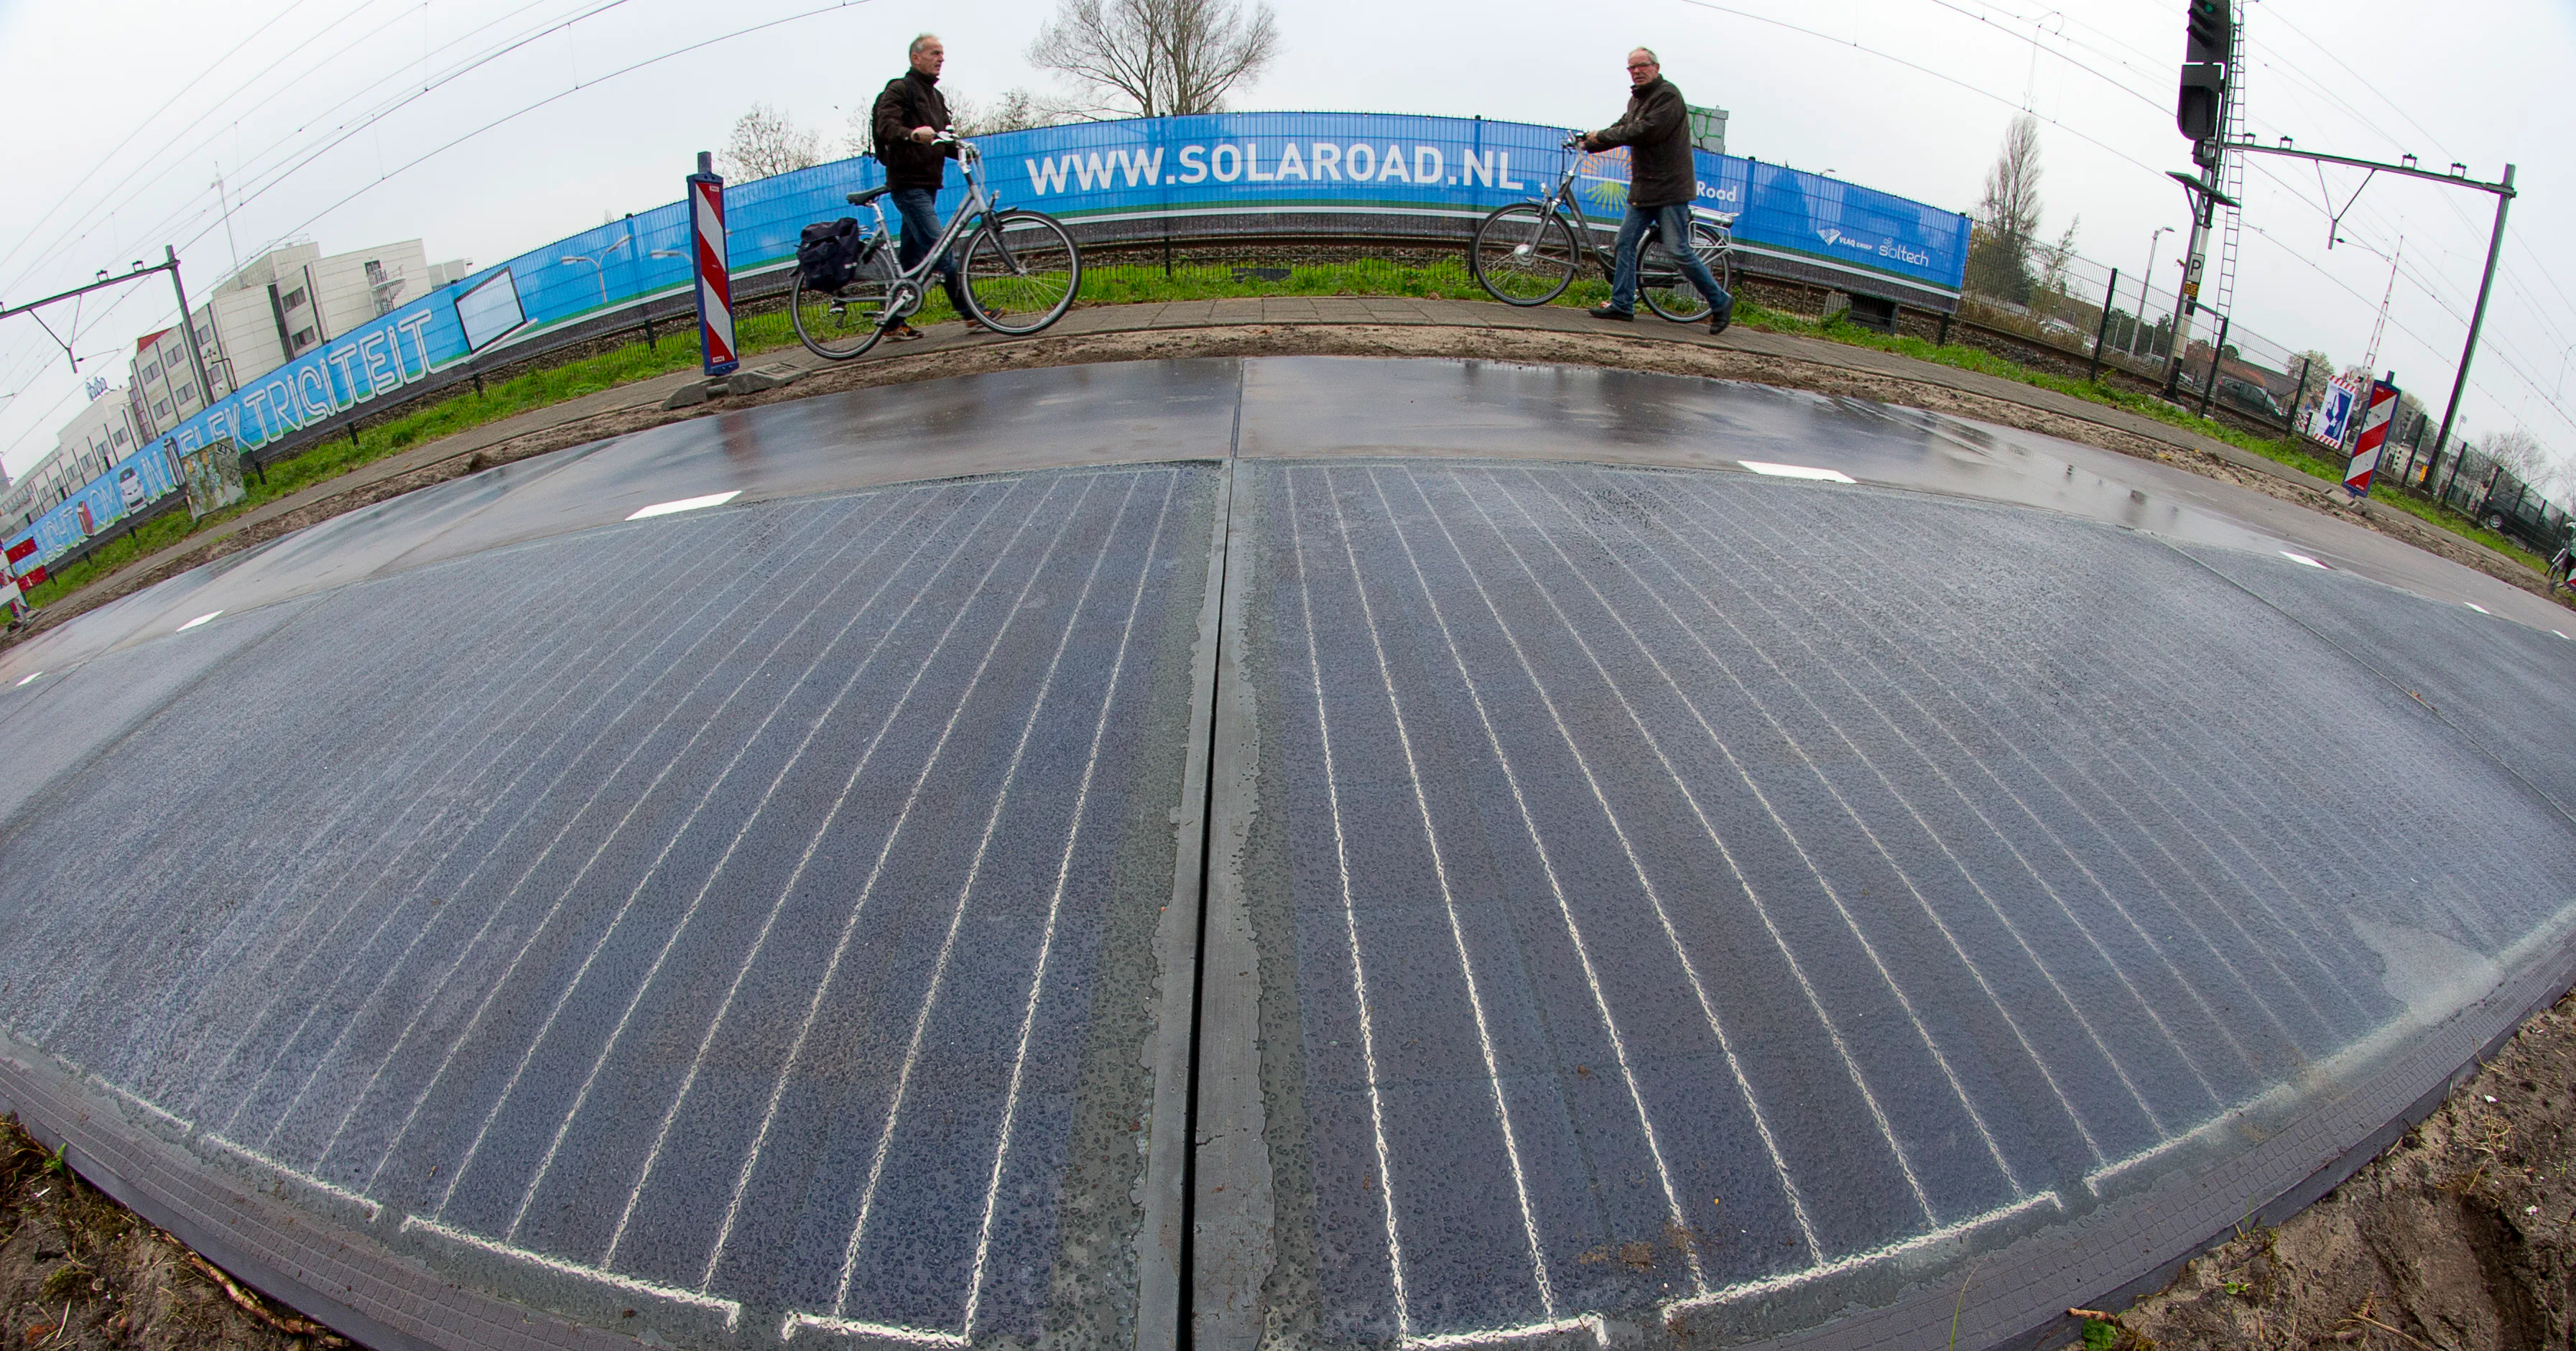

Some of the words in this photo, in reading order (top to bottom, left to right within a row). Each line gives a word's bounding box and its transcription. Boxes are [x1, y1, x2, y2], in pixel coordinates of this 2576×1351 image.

[1025, 142, 1524, 195] WWW.SOLAROAD.NL
[1696, 180, 1737, 203] Road
[2190, 259, 2202, 276] P
